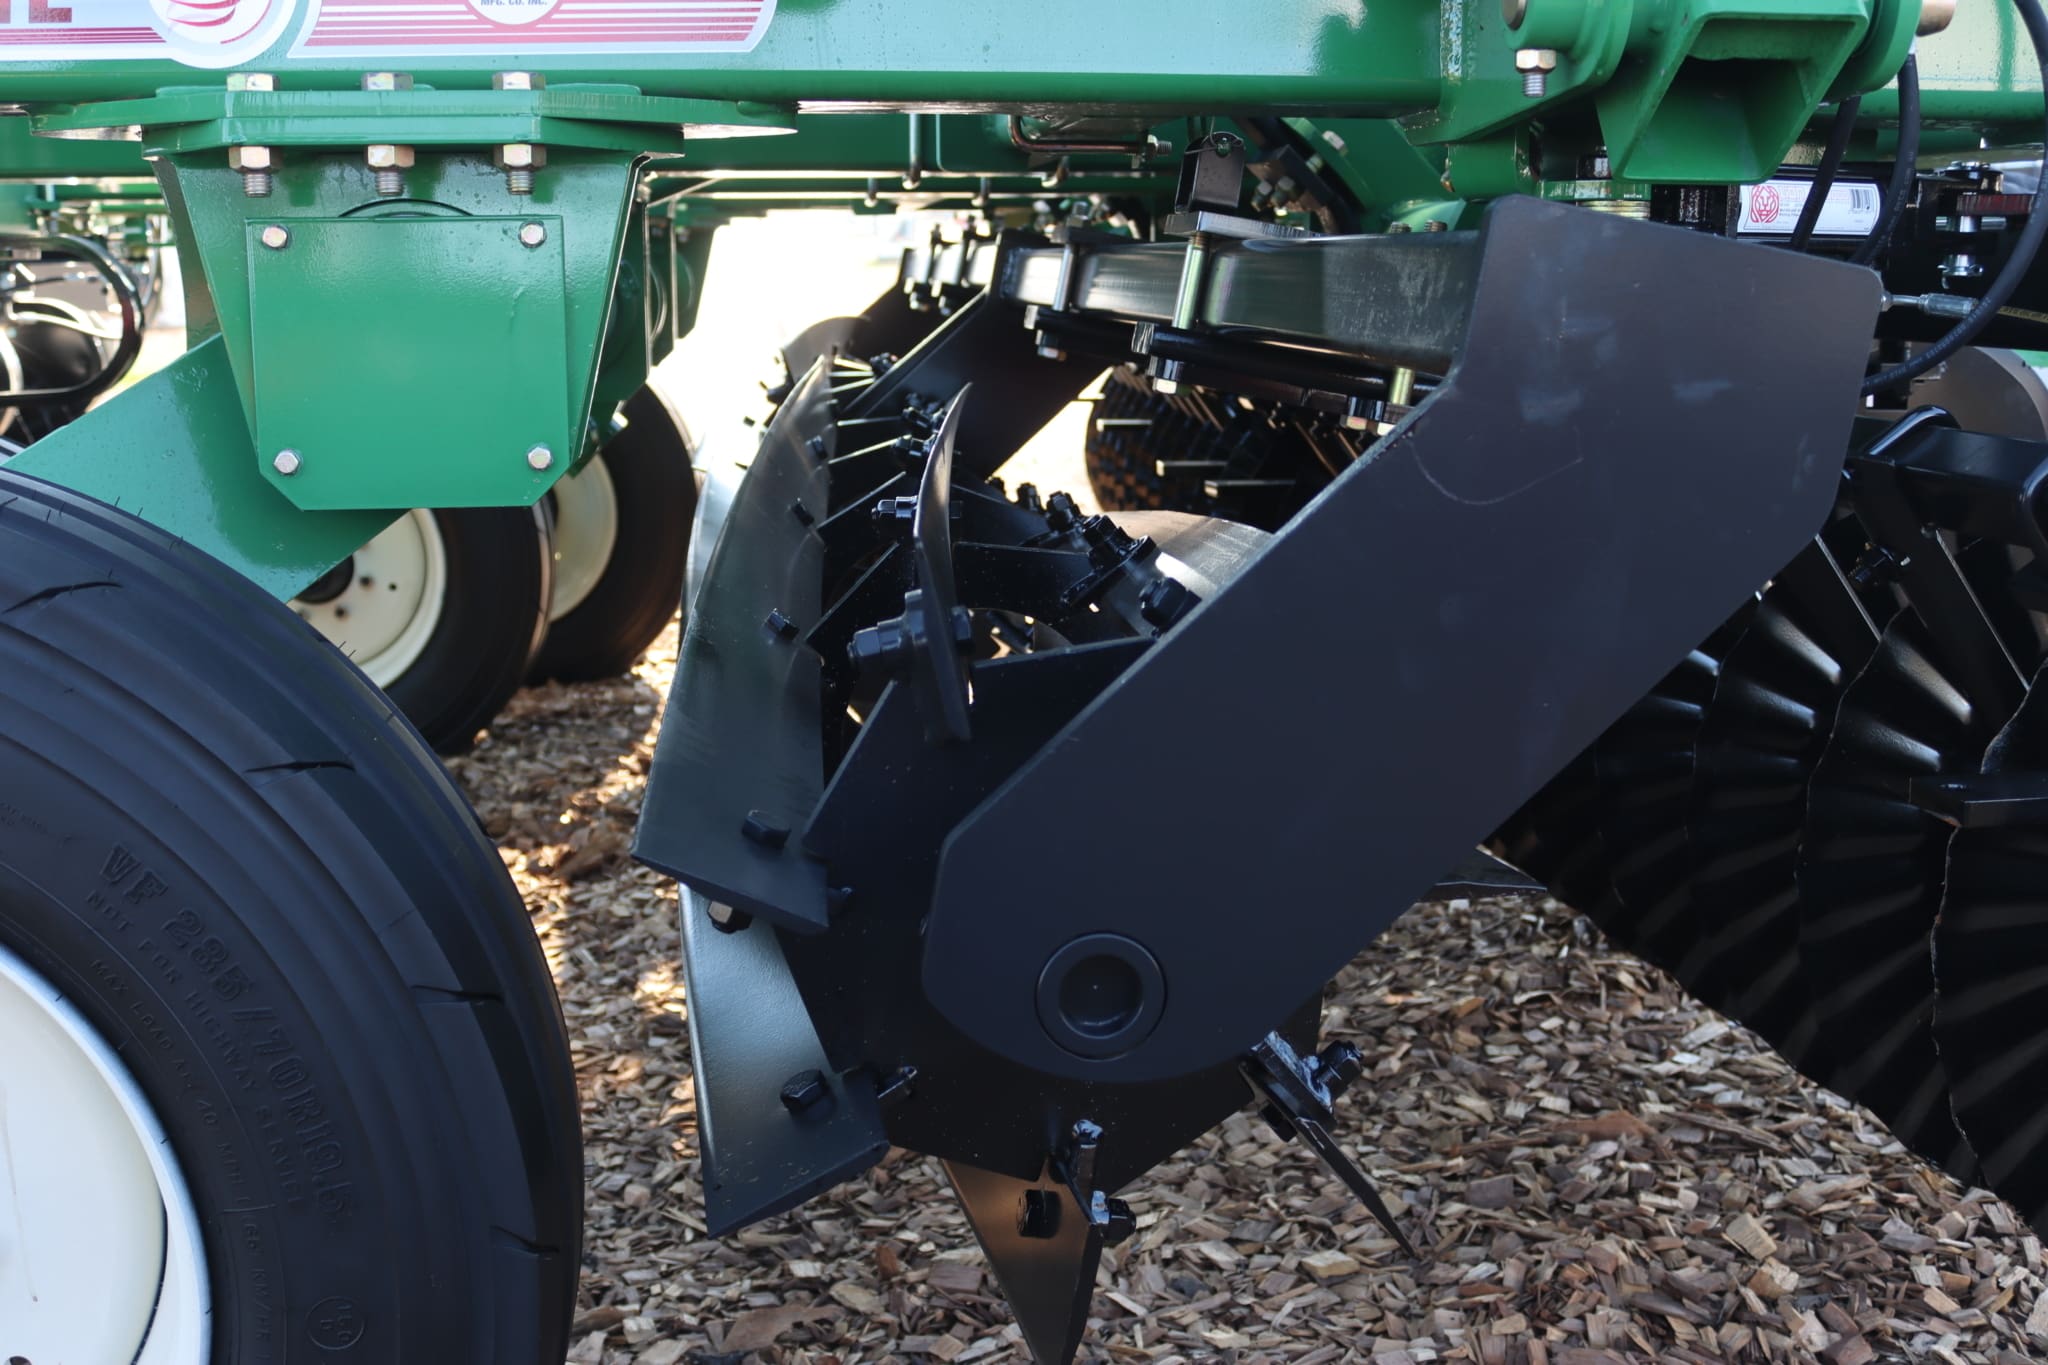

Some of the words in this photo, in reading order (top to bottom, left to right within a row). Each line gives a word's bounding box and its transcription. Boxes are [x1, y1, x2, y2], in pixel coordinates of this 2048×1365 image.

[99, 839, 168, 907] VF
[84, 888, 134, 933] NOT
[137, 937, 183, 985] FOR
[185, 990, 260, 1092] HIGHWAY
[88, 957, 130, 996] MAX
